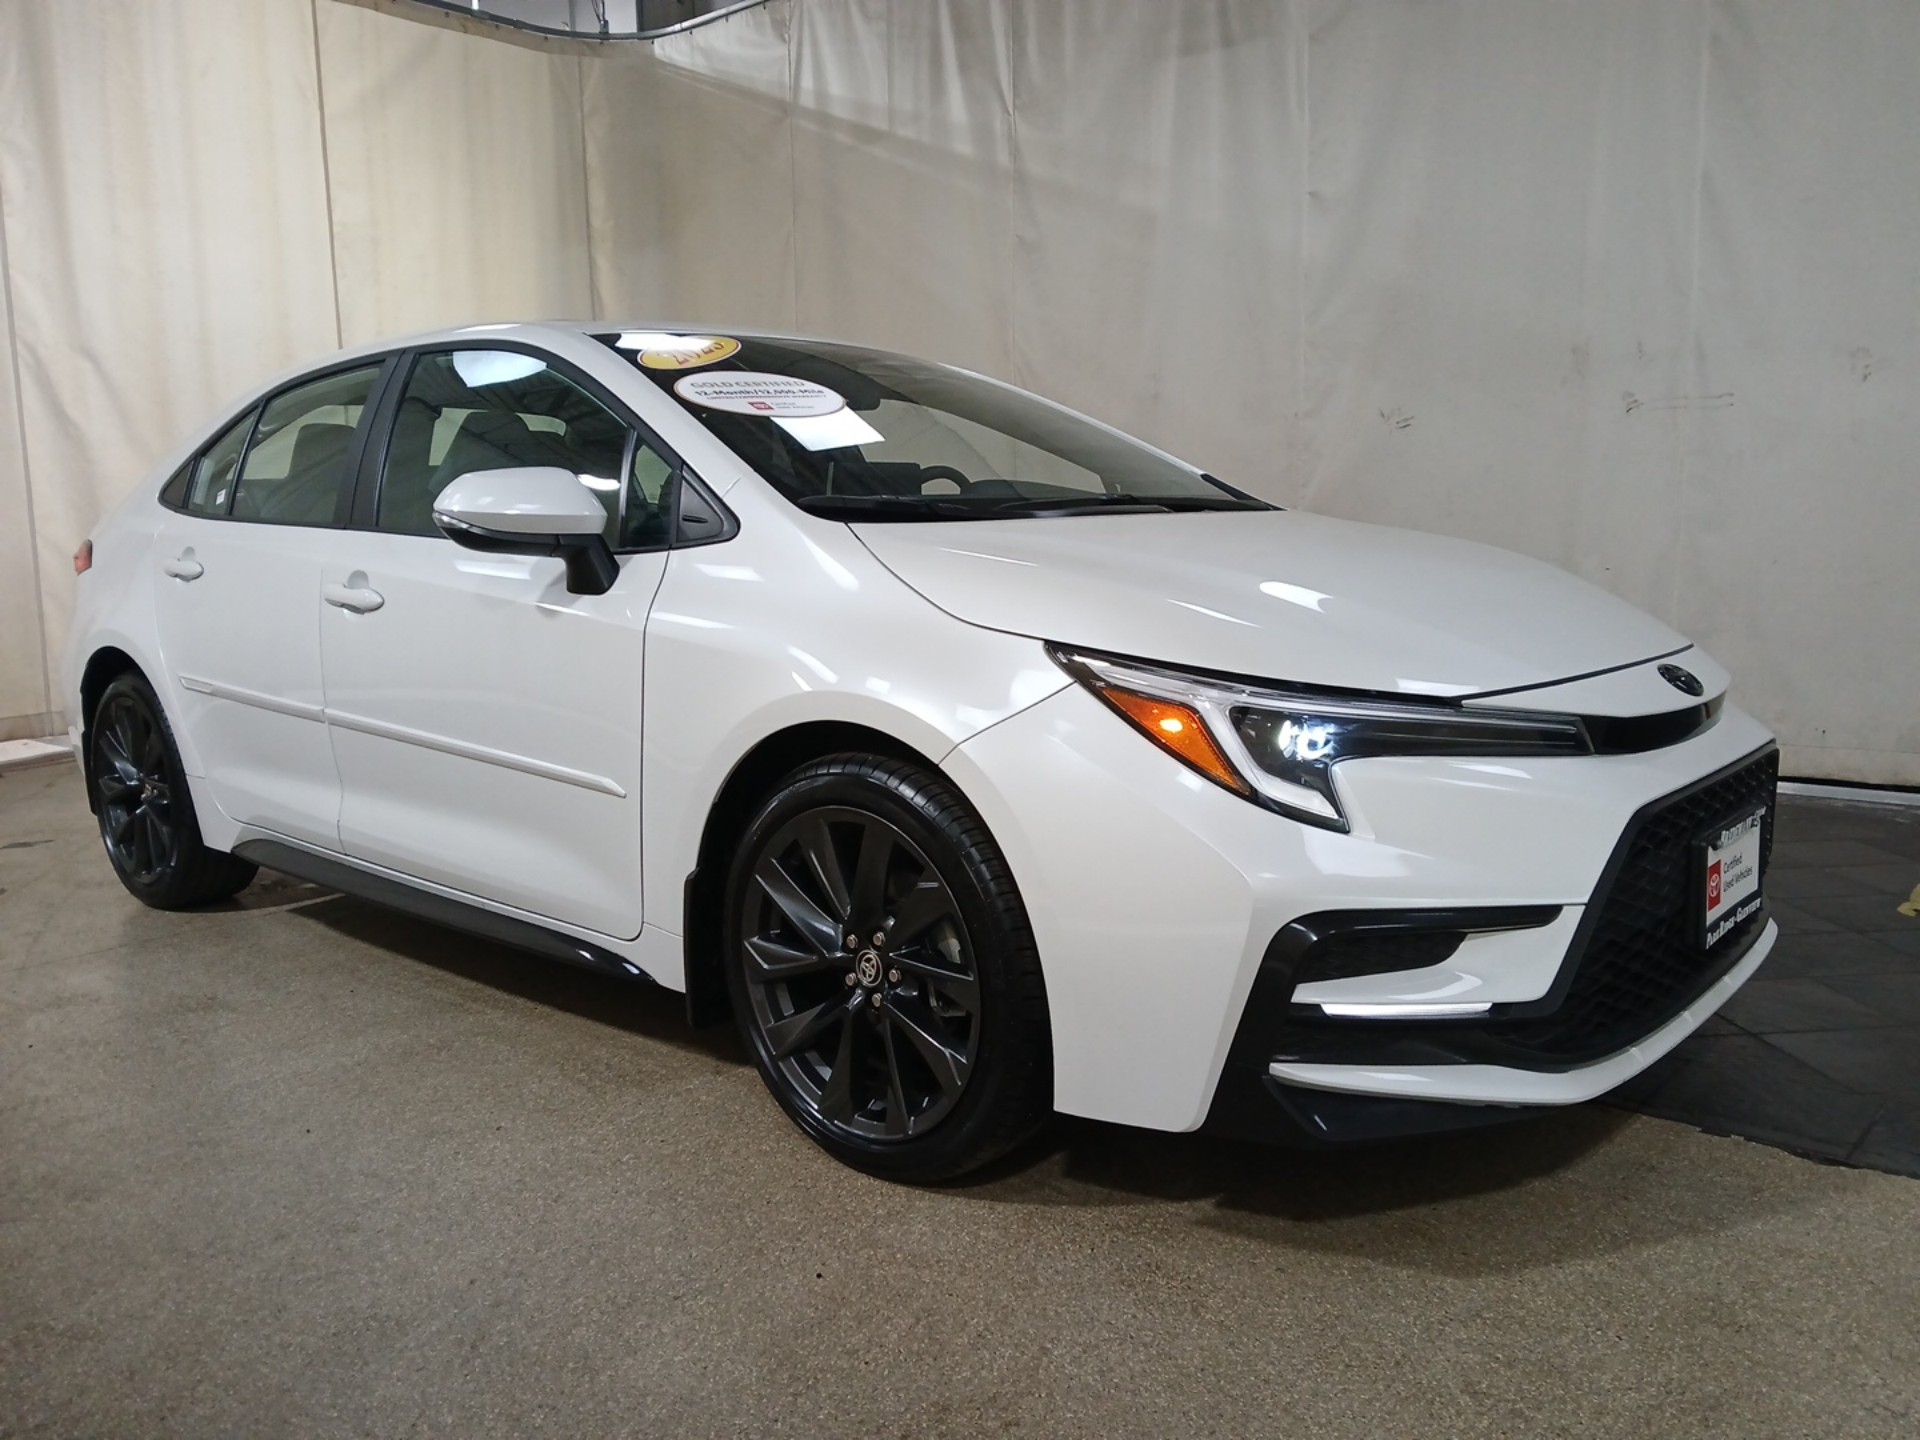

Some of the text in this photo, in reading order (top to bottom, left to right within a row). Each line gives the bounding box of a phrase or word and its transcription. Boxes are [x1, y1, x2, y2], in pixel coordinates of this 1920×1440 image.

[1723, 852, 1743, 874] Certified
[1723, 866, 1753, 892] Used Vehicles
